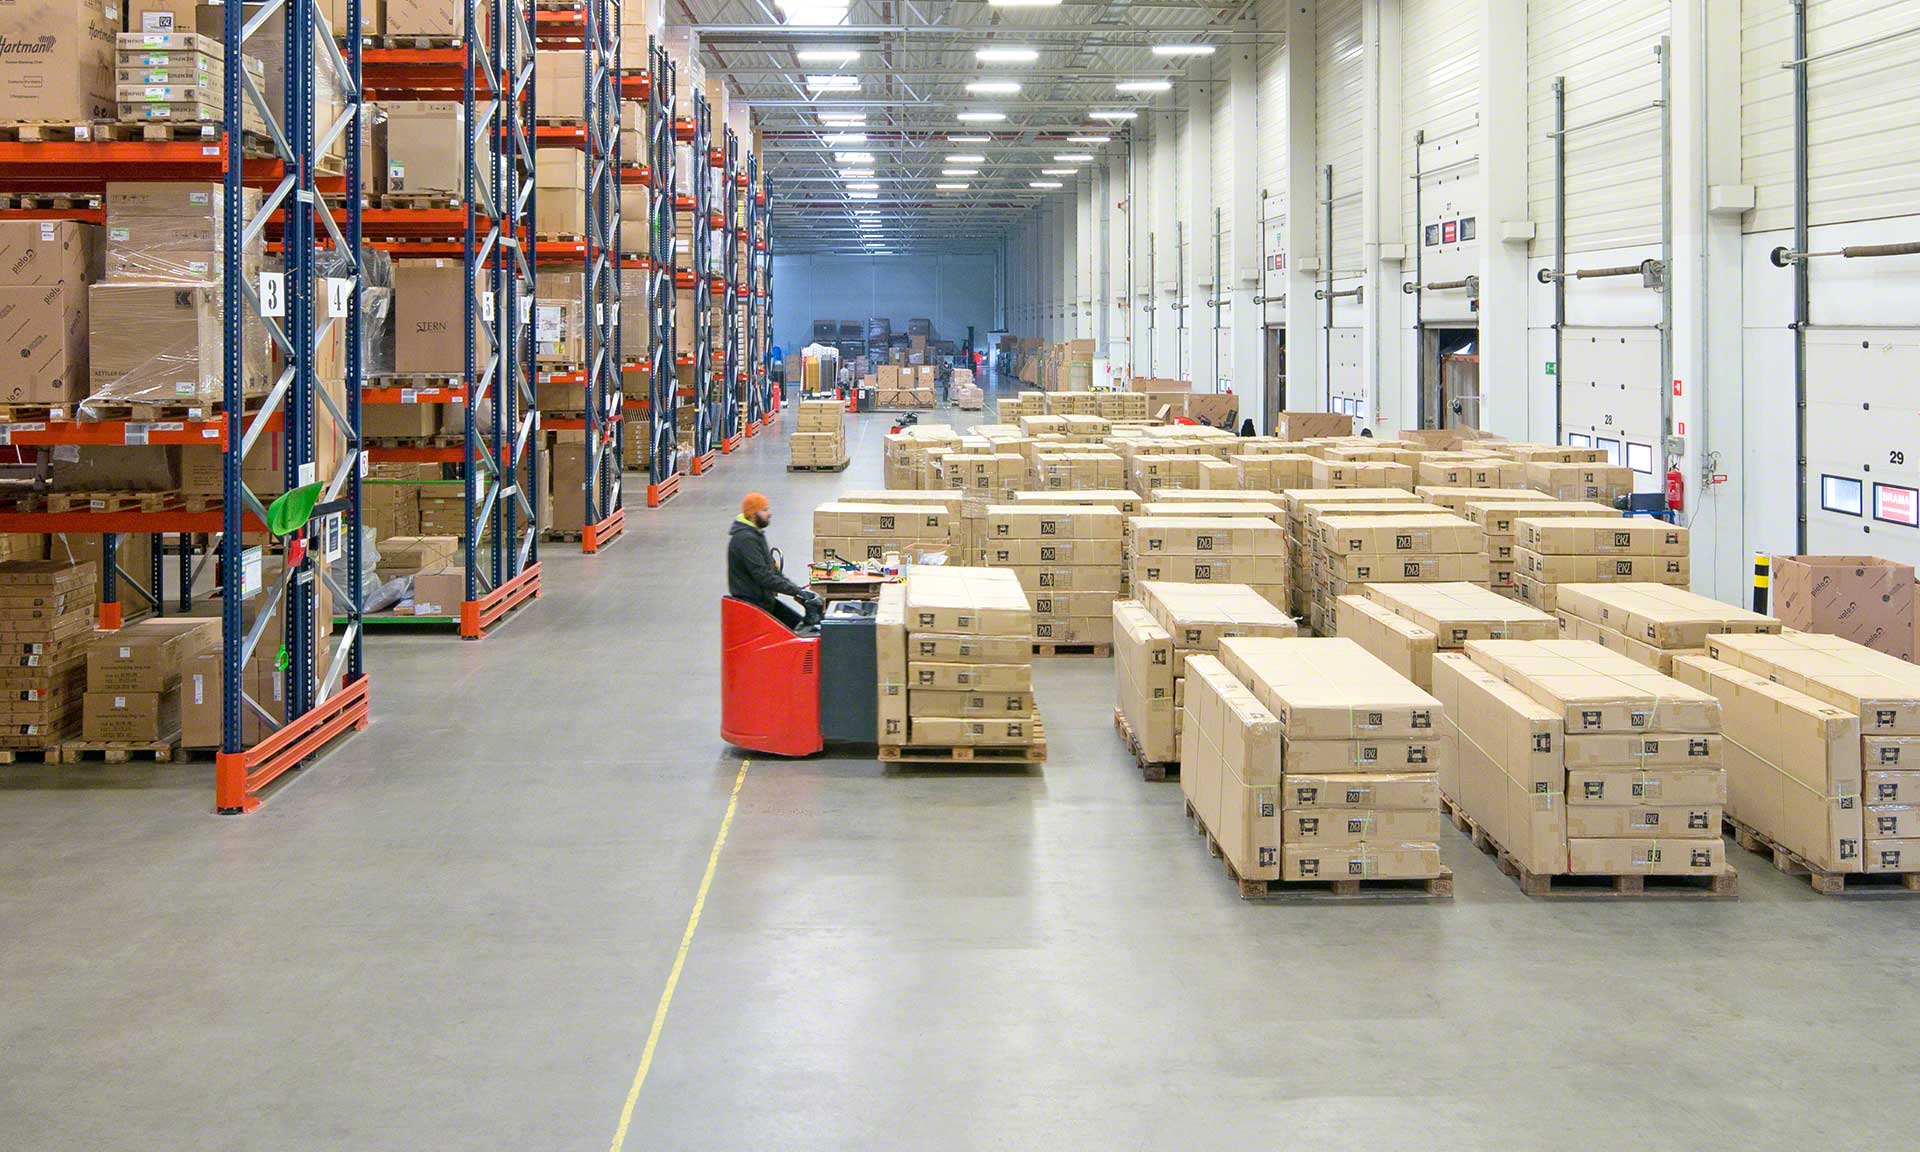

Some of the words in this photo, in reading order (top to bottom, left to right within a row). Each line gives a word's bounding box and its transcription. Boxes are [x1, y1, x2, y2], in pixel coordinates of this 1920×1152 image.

[268, 279, 278, 310] 3
[416, 321, 447, 332] STERN
[1604, 414, 1613, 425] 28
[1889, 450, 1904, 465] 29
